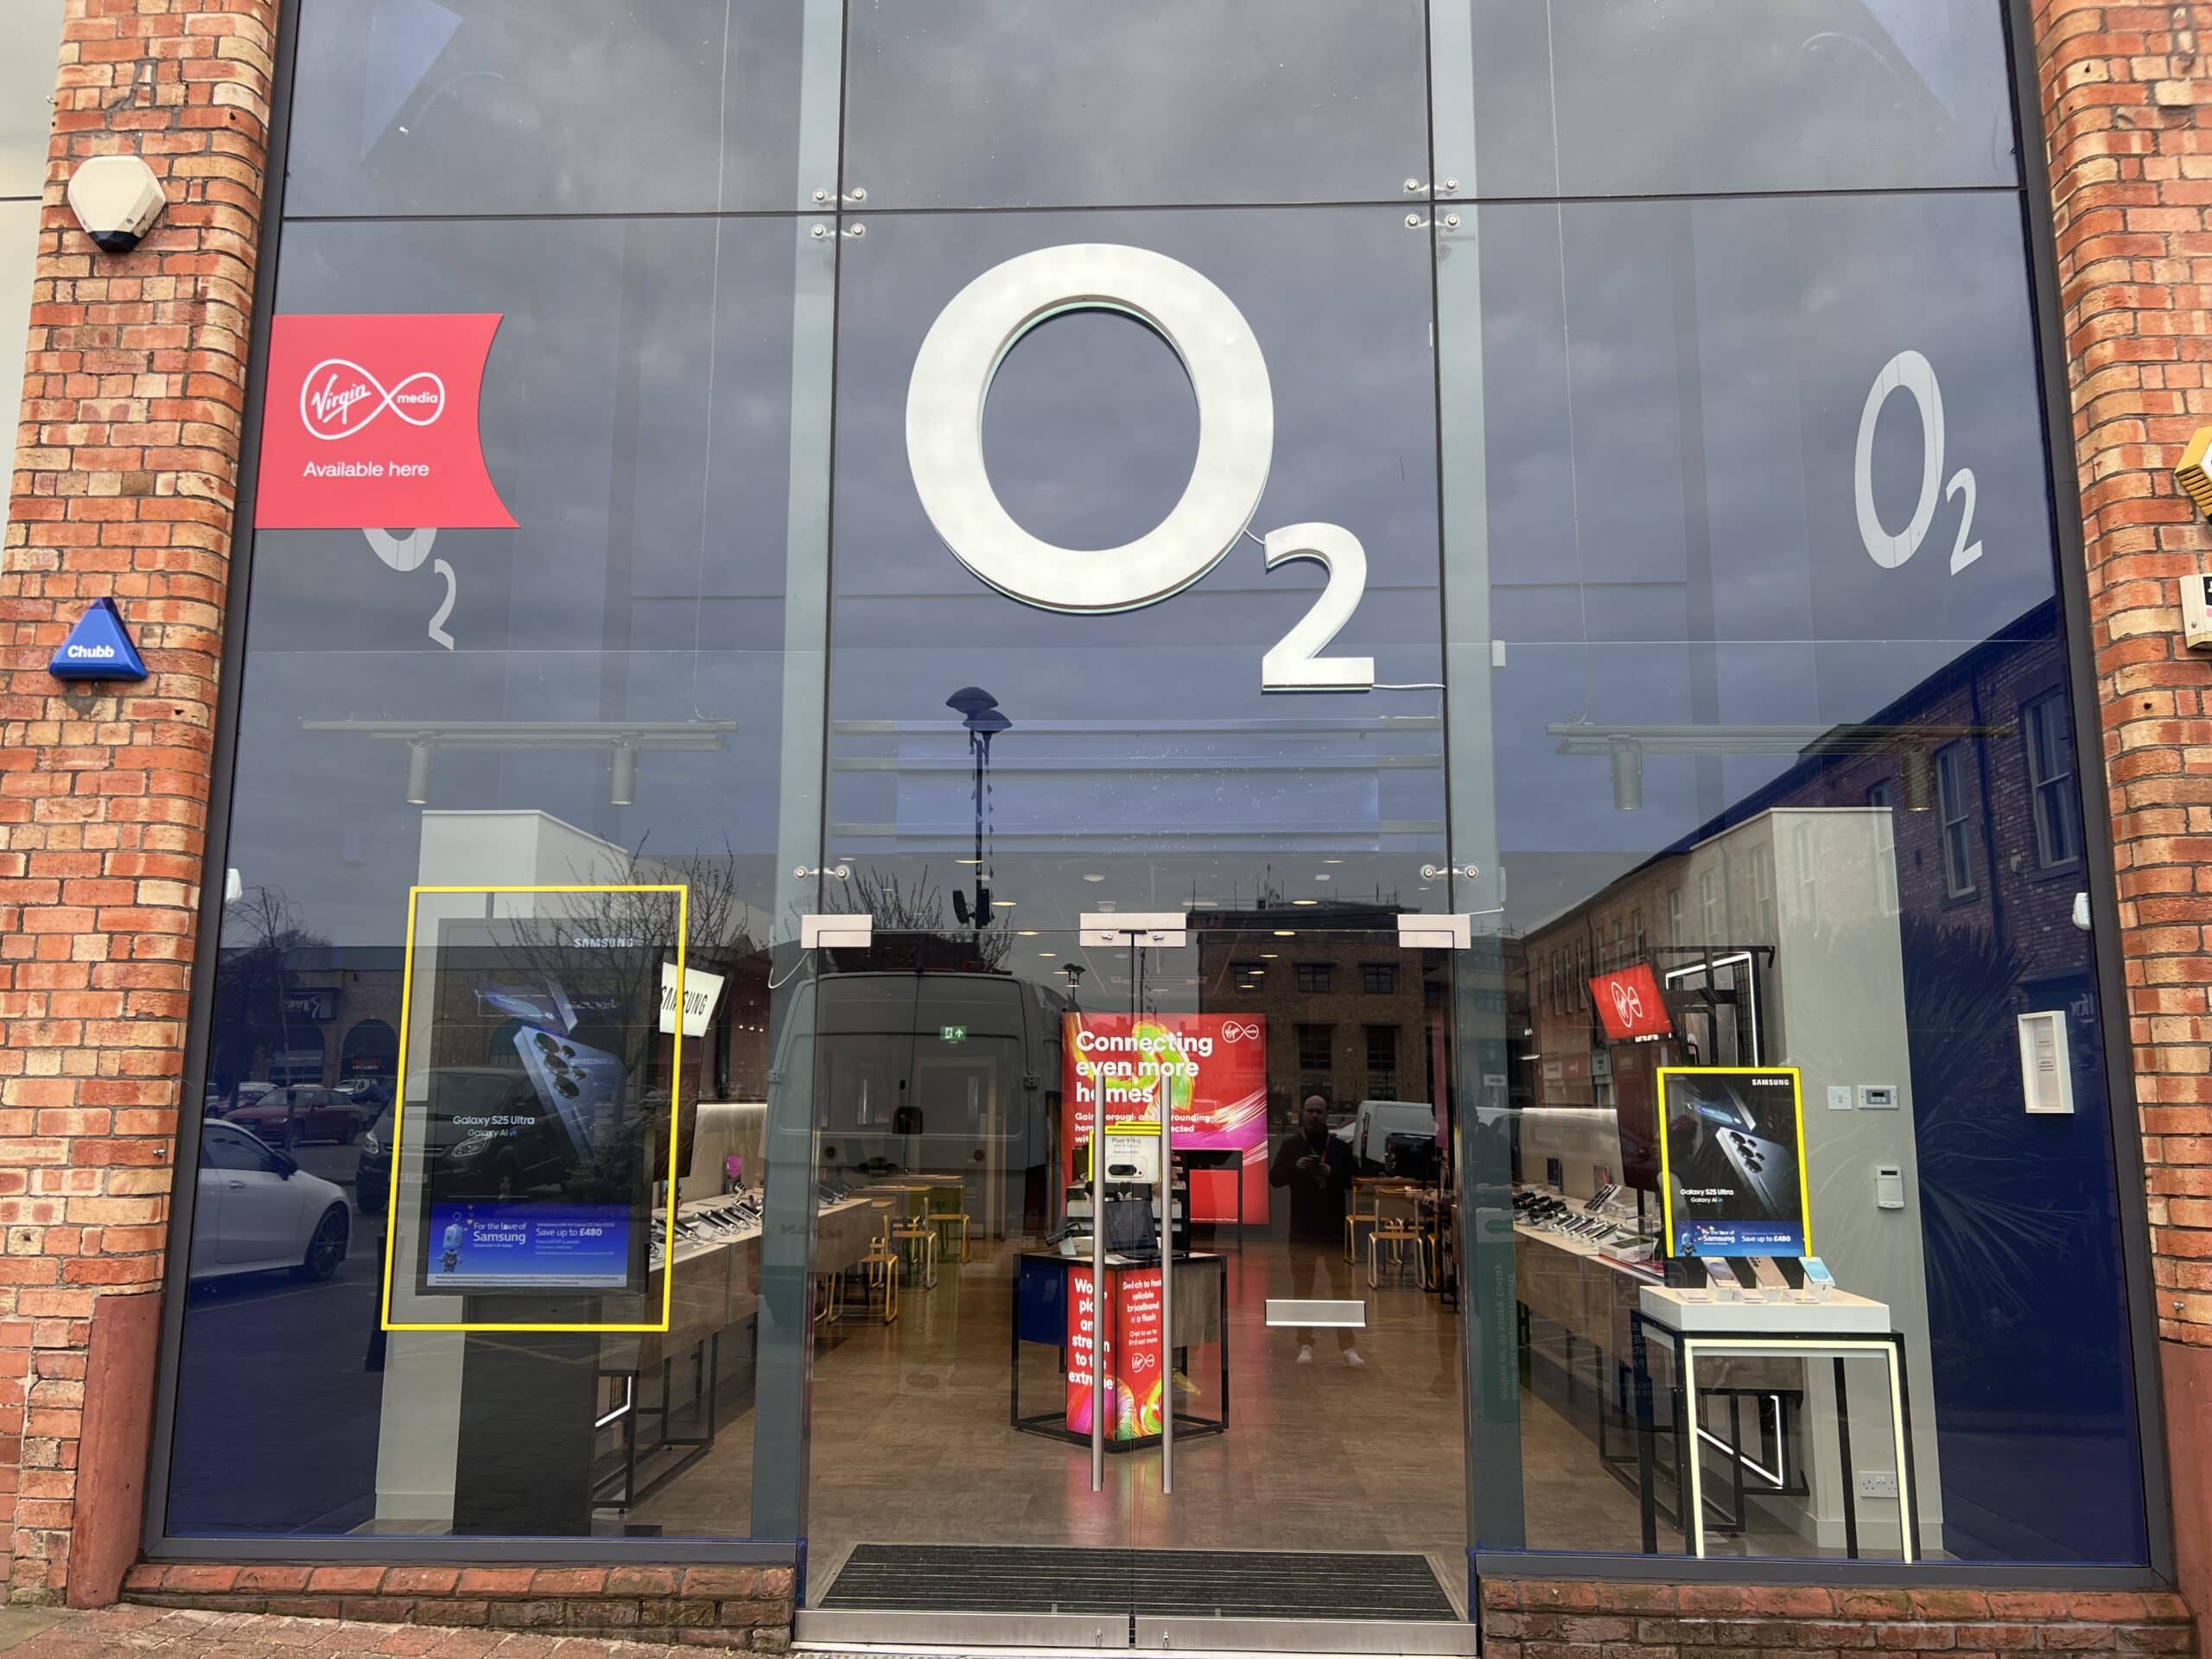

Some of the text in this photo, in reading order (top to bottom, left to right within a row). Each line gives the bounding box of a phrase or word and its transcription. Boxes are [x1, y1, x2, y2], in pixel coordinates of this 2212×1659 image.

[311, 373, 438, 424] Virgin media
[303, 461, 429, 477] Available here
[67, 645, 115, 658] Chubb
[574, 938, 633, 948] SAMSUNG
[1076, 1031, 1213, 1057] Connecting
[1076, 1060, 1199, 1077] even more
[1076, 1082, 1154, 1103] hmes
[453, 1116, 535, 1127] Galaxy S25 Ultra
[1138, 1113, 1155, 1122] and
[467, 1128, 498, 1138] Galaxy
[1074, 1135, 1090, 1143] wit
[518, 1222, 528, 1230] of
[473, 1230, 526, 1245] Samsung
[536, 1228, 555, 1236] Save
[556, 1230, 568, 1238] up
[580, 1228, 602, 1236] £480
[1703, 1236, 1736, 1244] Samsung
[1080, 1319, 1093, 1332] an
[1071, 1333, 1110, 1353] strem
[1075, 1351, 1087, 1367] to
[1068, 1371, 1114, 1390] extre
